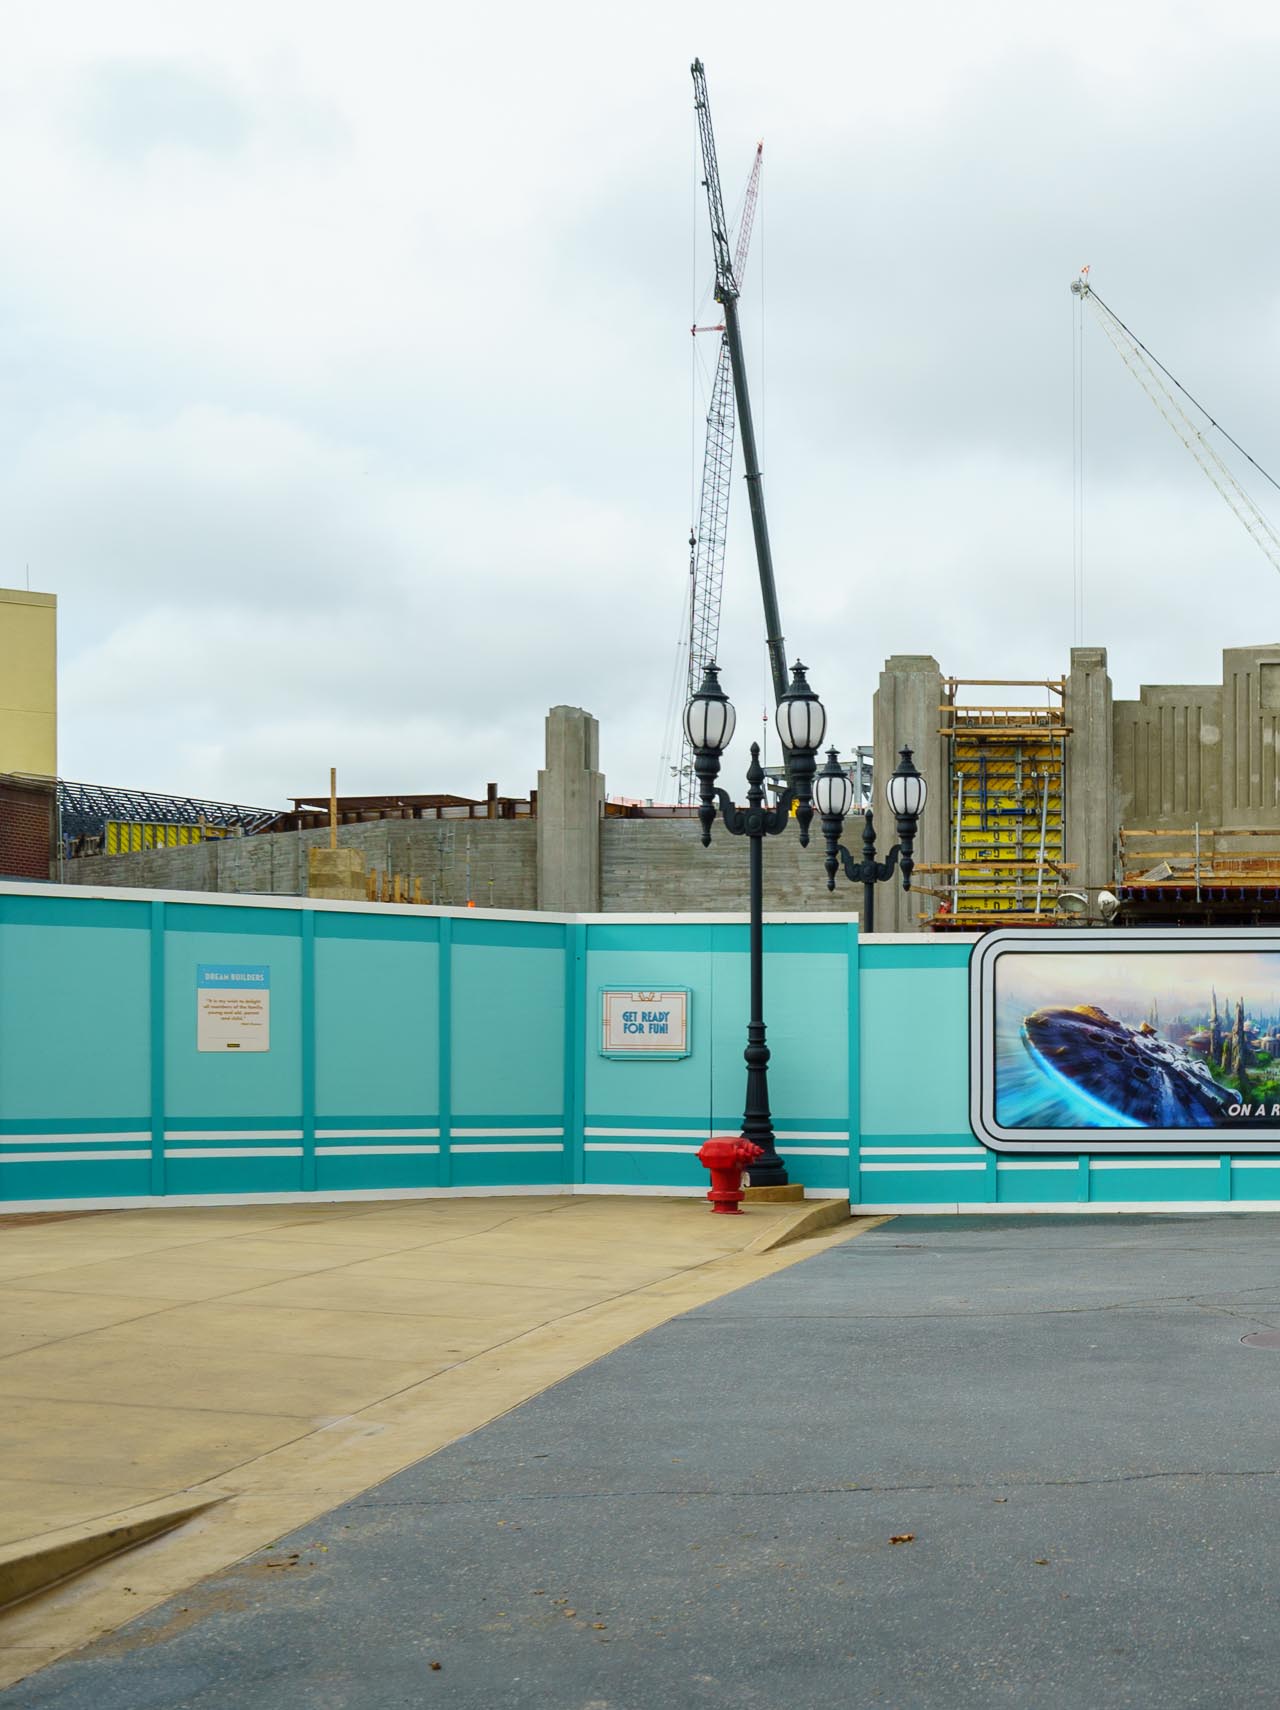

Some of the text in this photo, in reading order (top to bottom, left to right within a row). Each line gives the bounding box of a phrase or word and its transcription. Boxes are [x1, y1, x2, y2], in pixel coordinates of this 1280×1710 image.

[622, 1011, 670, 1022] GET READY
[623, 1023, 669, 1034] FOR FUN!
[1228, 1103, 1252, 1117] ON
[1254, 1103, 1267, 1117] A
